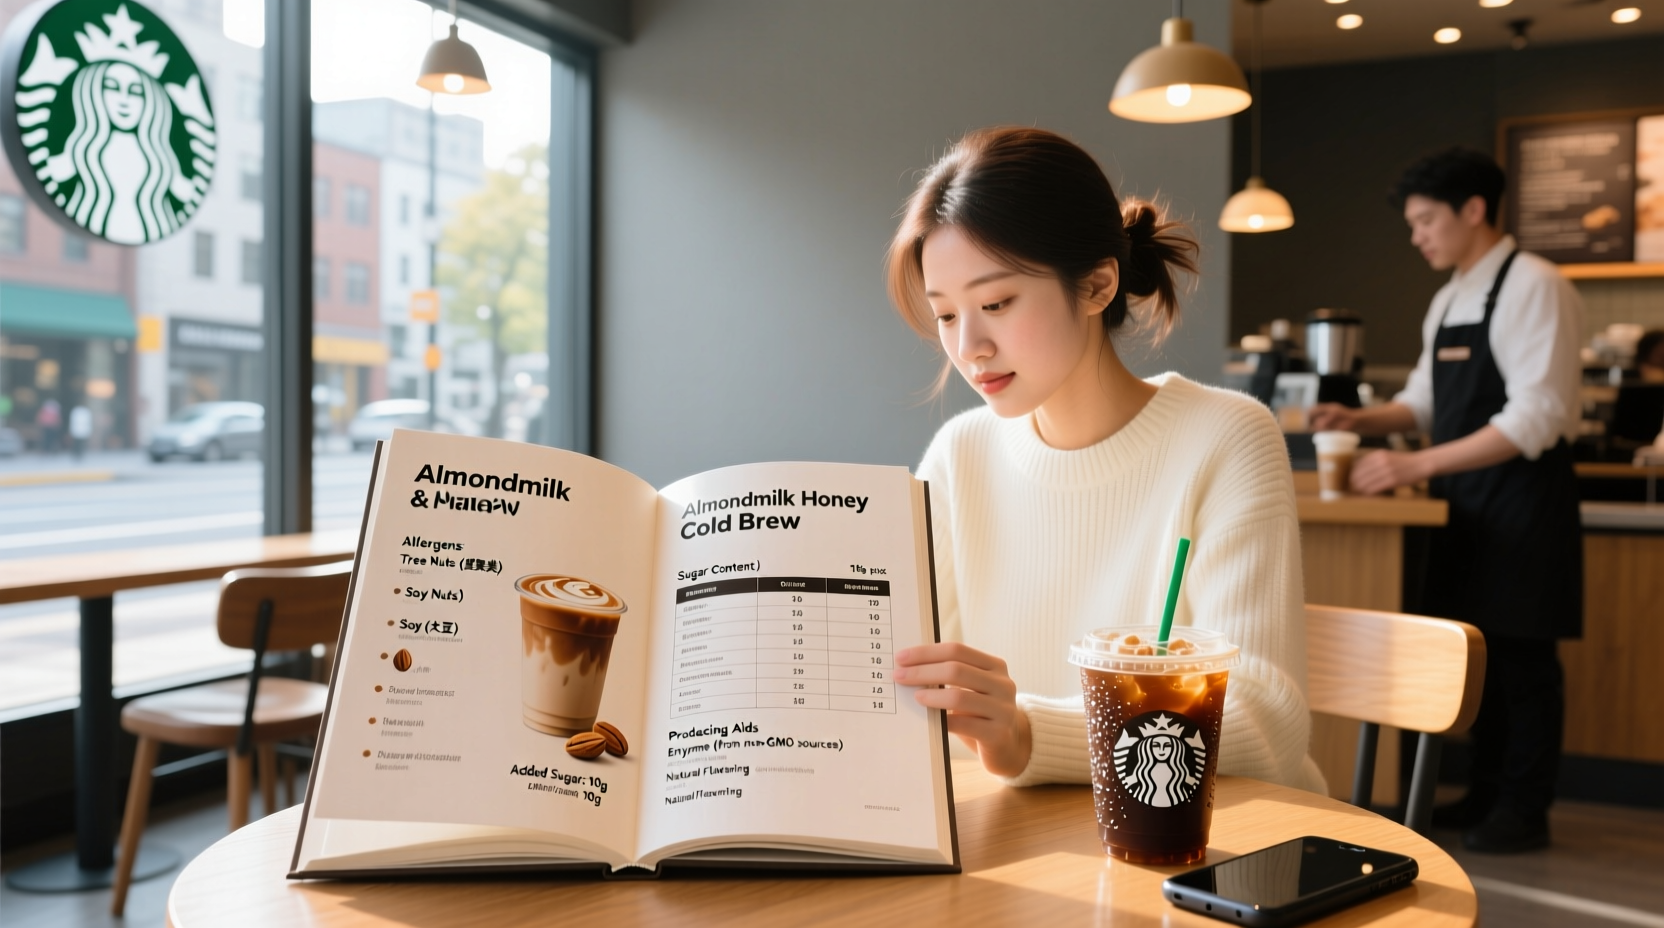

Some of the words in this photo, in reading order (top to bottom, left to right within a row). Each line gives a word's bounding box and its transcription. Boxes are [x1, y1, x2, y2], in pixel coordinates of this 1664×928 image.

[414, 463, 571, 501] Almondmilk
[411, 489, 428, 508] &
[681, 488, 796, 519] Almondmilk
[801, 490, 869, 513] Honey
[680, 514, 732, 540] Cold
[739, 512, 801, 531] Brew
[400, 553, 427, 565] Tree
[677, 566, 709, 581] Sugar
[711, 560, 761, 574] Content)
[405, 587, 428, 601] Soy
[399, 618, 422, 633] Soy
[510, 764, 548, 778] Added
[551, 768, 586, 785] Sugar:
[589, 776, 608, 793] 10g
